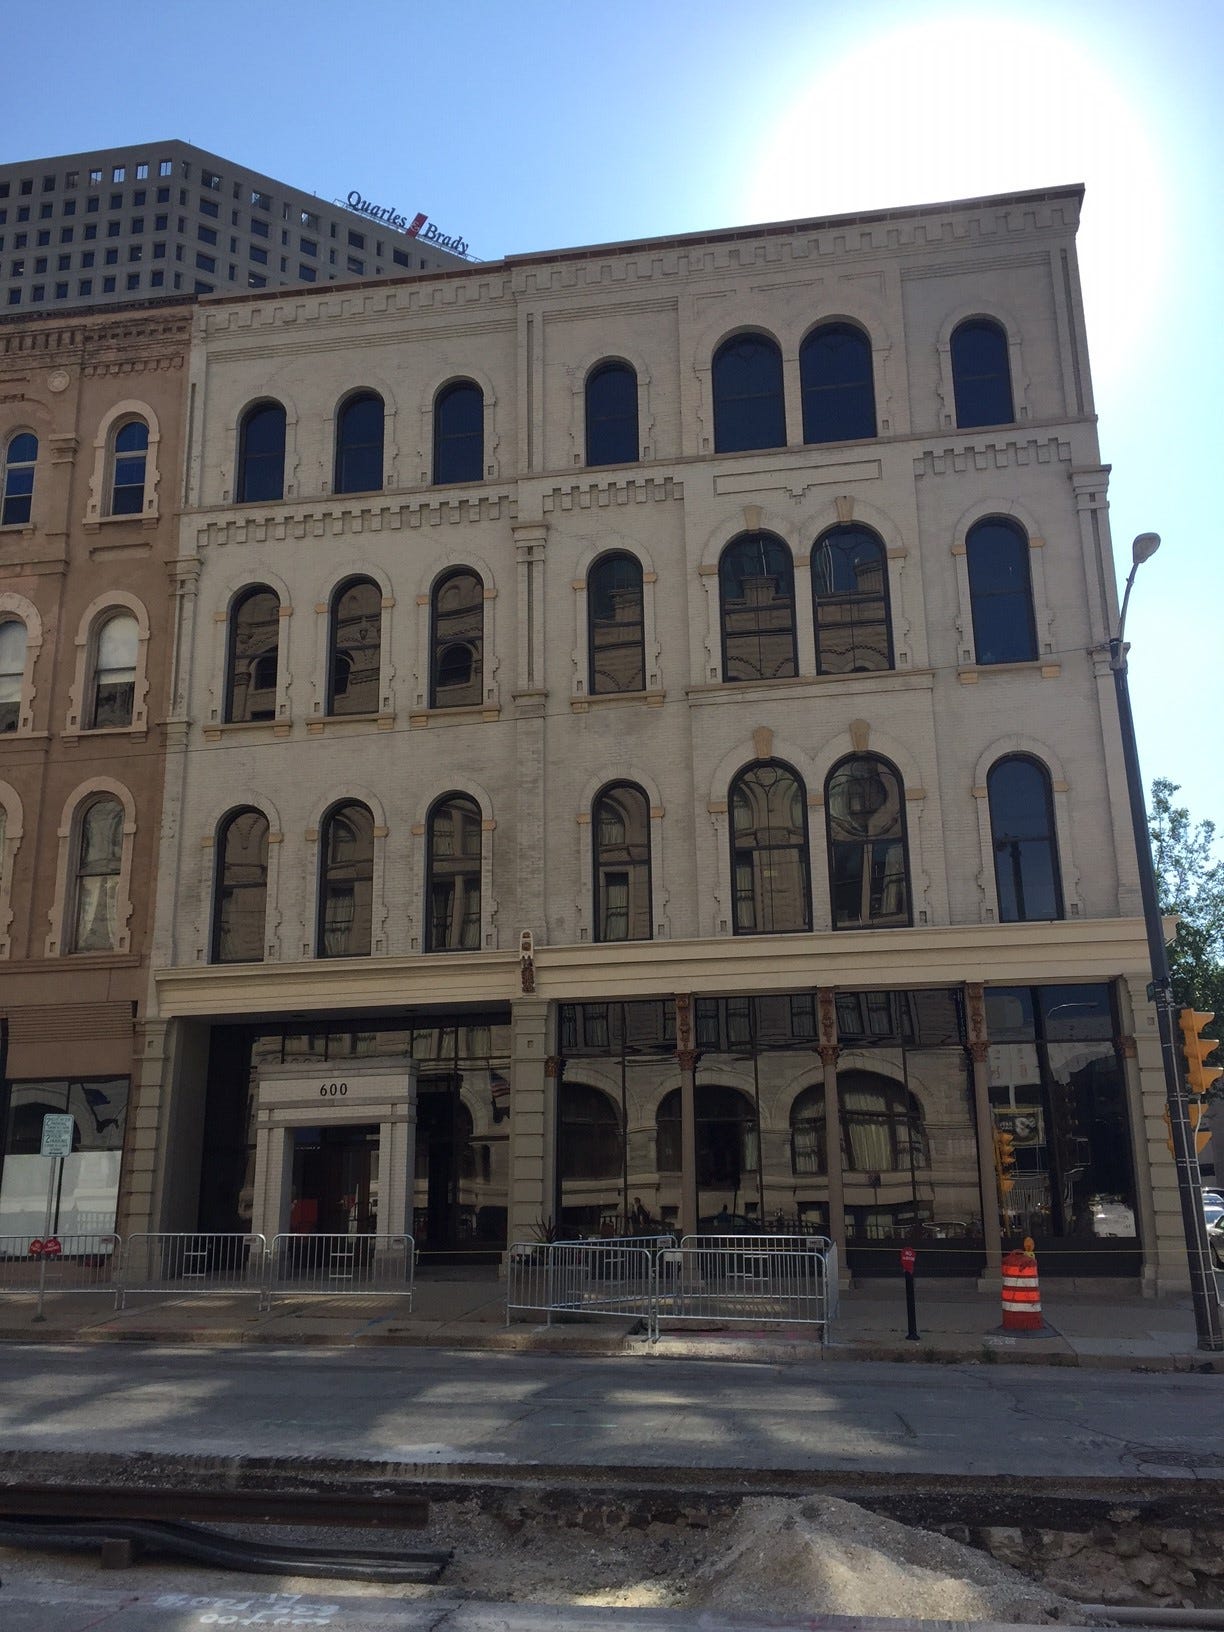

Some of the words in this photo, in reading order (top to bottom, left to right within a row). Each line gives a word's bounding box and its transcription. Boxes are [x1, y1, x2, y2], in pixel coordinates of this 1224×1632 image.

[347, 191, 407, 229] Quarles
[422, 222, 469, 255] Brady
[320, 1083, 348, 1096] 600
